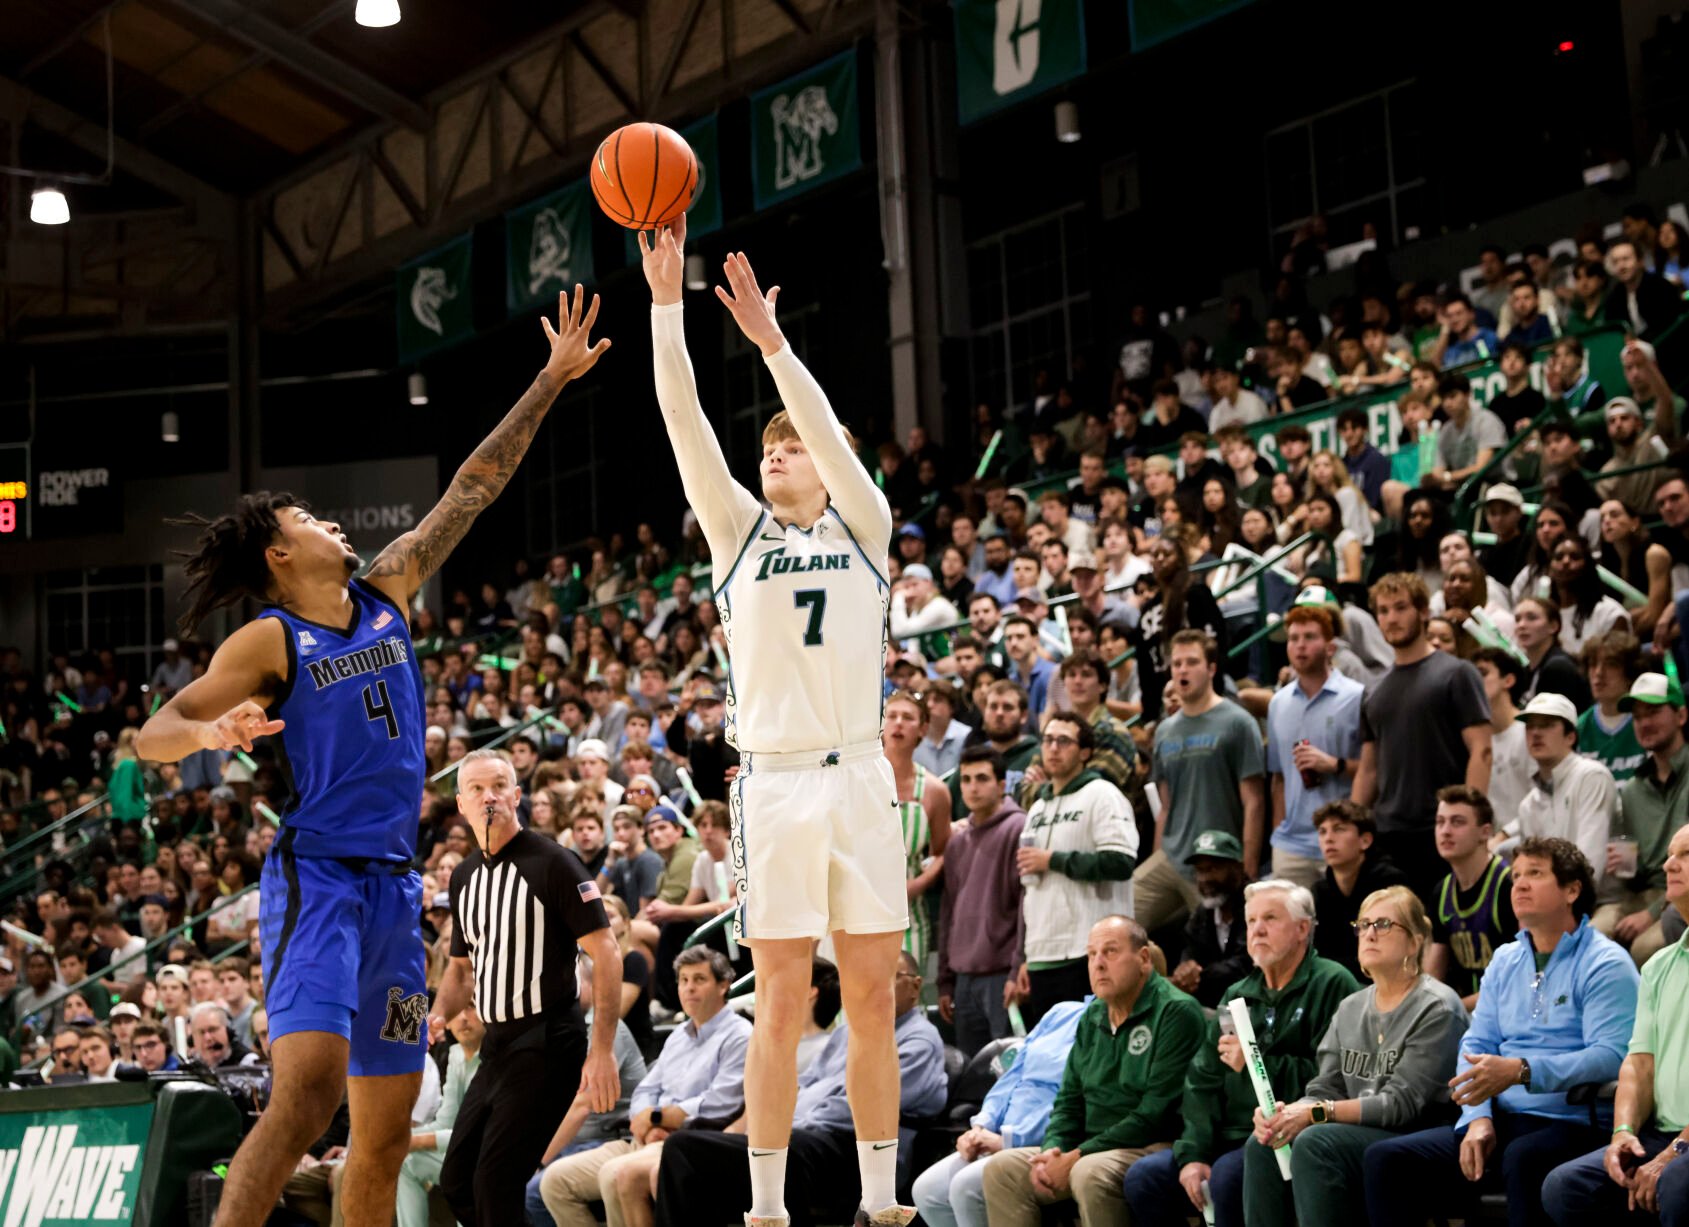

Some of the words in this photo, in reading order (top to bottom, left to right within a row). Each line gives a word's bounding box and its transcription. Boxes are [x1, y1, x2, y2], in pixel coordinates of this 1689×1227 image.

[39, 467, 109, 490] POWER
[793, 588, 827, 647] 7
[304, 635, 409, 691] Memphis
[362, 679, 400, 740] 4
[2, 1124, 140, 1227] WAVE
